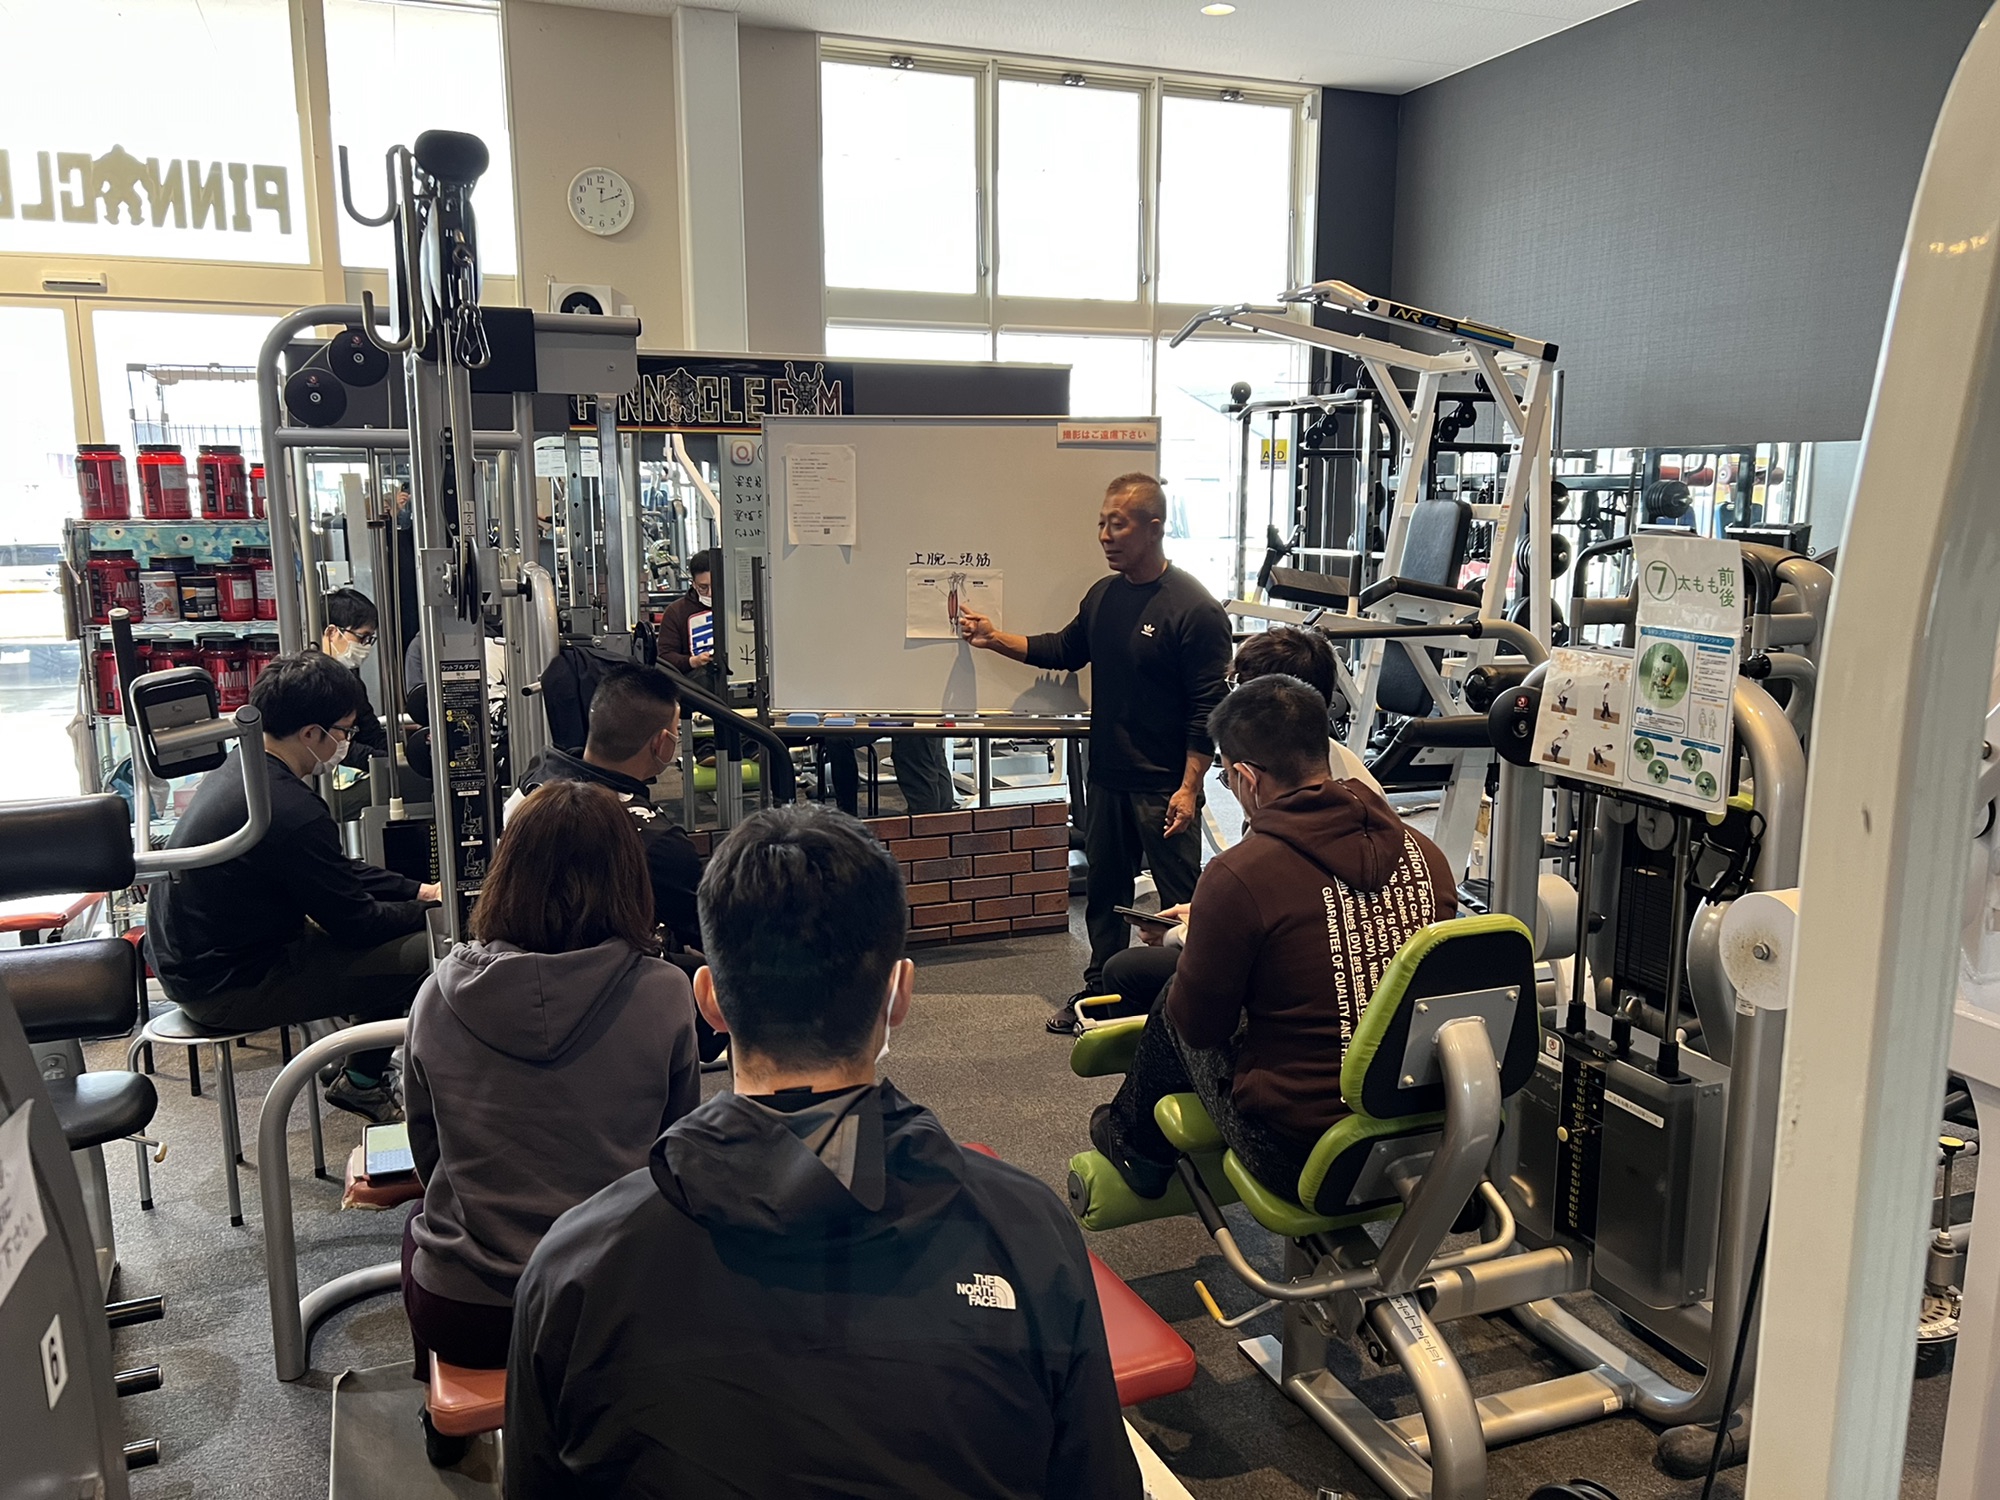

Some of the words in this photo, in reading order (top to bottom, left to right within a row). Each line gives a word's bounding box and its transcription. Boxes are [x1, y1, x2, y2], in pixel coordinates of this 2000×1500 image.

[586, 177, 593, 186] 11
[597, 175, 605, 184] 12
[579, 185, 587, 193] 10
[576, 196, 583, 204] 9
[620, 200, 626, 208] 3
[580, 207, 586, 215] 8
[588, 216, 594, 224] 7
[599, 220, 605, 228] 6
[610, 218, 616, 226] 5
[1062, 430, 1147, 440] 撮影はご遠慮下さい
[466, 514, 472, 523] 2
[467, 525, 473, 534] 3
[1406, 885, 1415, 901] Fat
[1417, 880, 1431, 916] Facts
[1345, 896, 1357, 930] Values
[1373, 905, 1382, 914] C
[1394, 887, 1409, 927] Cholest.
[1409, 903, 1419, 923] Cal.
[1322, 886, 1342, 954] GUARANTEE
[1386, 911, 1396, 925] 1g
[1361, 920, 1377, 960] (2%DV),
[1373, 915, 1390, 955] (0%DV),
[1348, 932, 1362, 954] (DV)
[1331, 954, 1344, 970] OF
[1353, 956, 1363, 973] are
[1334, 971, 1350, 1018] QUALITY
[1356, 974, 1369, 1007] based
[1340, 1019, 1352, 1041] AND
[973, 1273, 995, 1286] THE
[956, 1283, 995, 1296] NORTH
[968, 1294, 997, 1308] FACE
